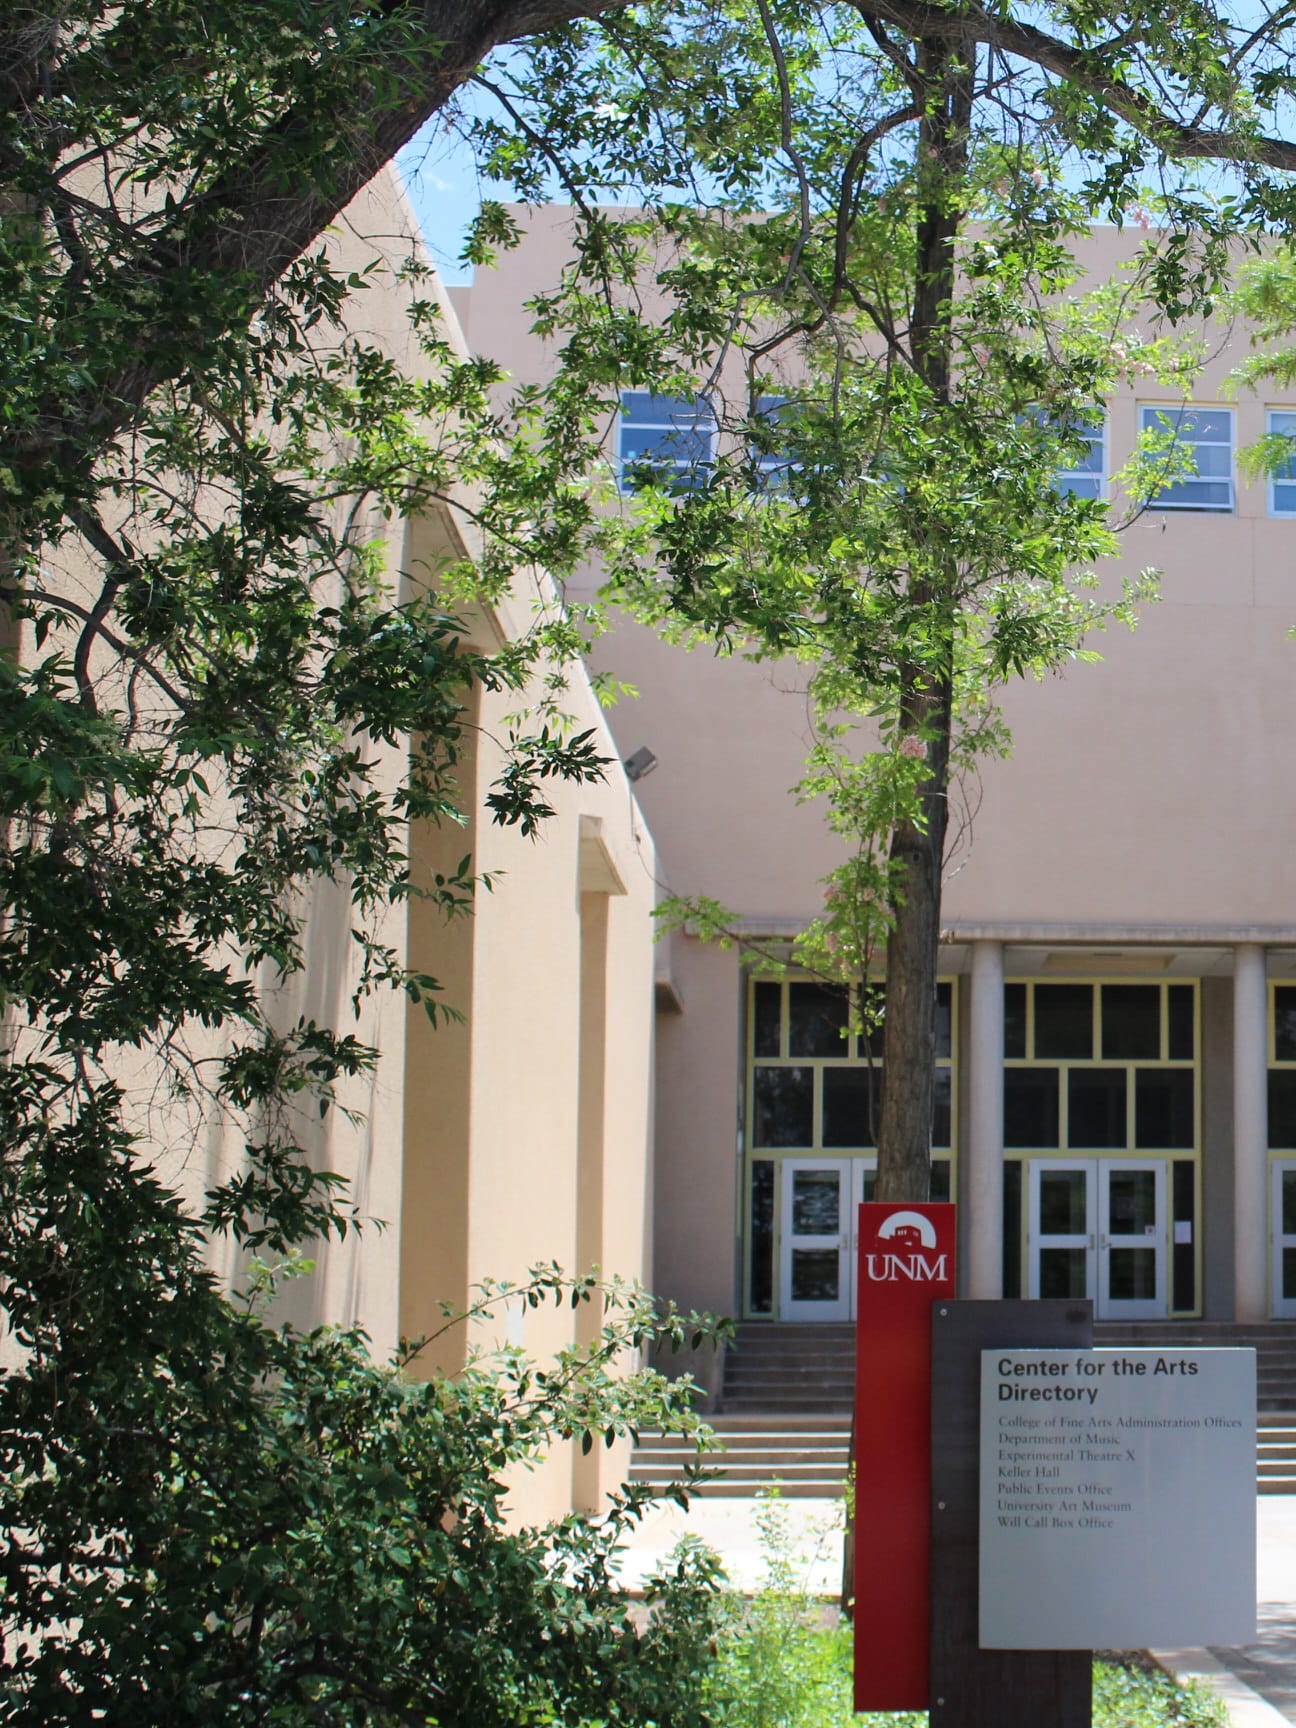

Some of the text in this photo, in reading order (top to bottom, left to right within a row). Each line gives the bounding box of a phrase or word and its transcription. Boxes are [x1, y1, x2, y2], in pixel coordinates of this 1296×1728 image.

[865, 1253, 948, 1282] UNM
[998, 1358, 1198, 1376] Center for the Arts
[999, 1384, 1098, 1404] Directory
[999, 1417, 1242, 1429] College of Fine Arts Administration Offices
[999, 1433, 1120, 1446] Department of Music
[999, 1450, 1135, 1463] Experimental Theatre X
[999, 1467, 1059, 1477] Keller Hall
[998, 1484, 1112, 1494] Public Events Office
[998, 1501, 1131, 1513] University Art Museum
[997, 1517, 1113, 1528] Will Call Box Office
